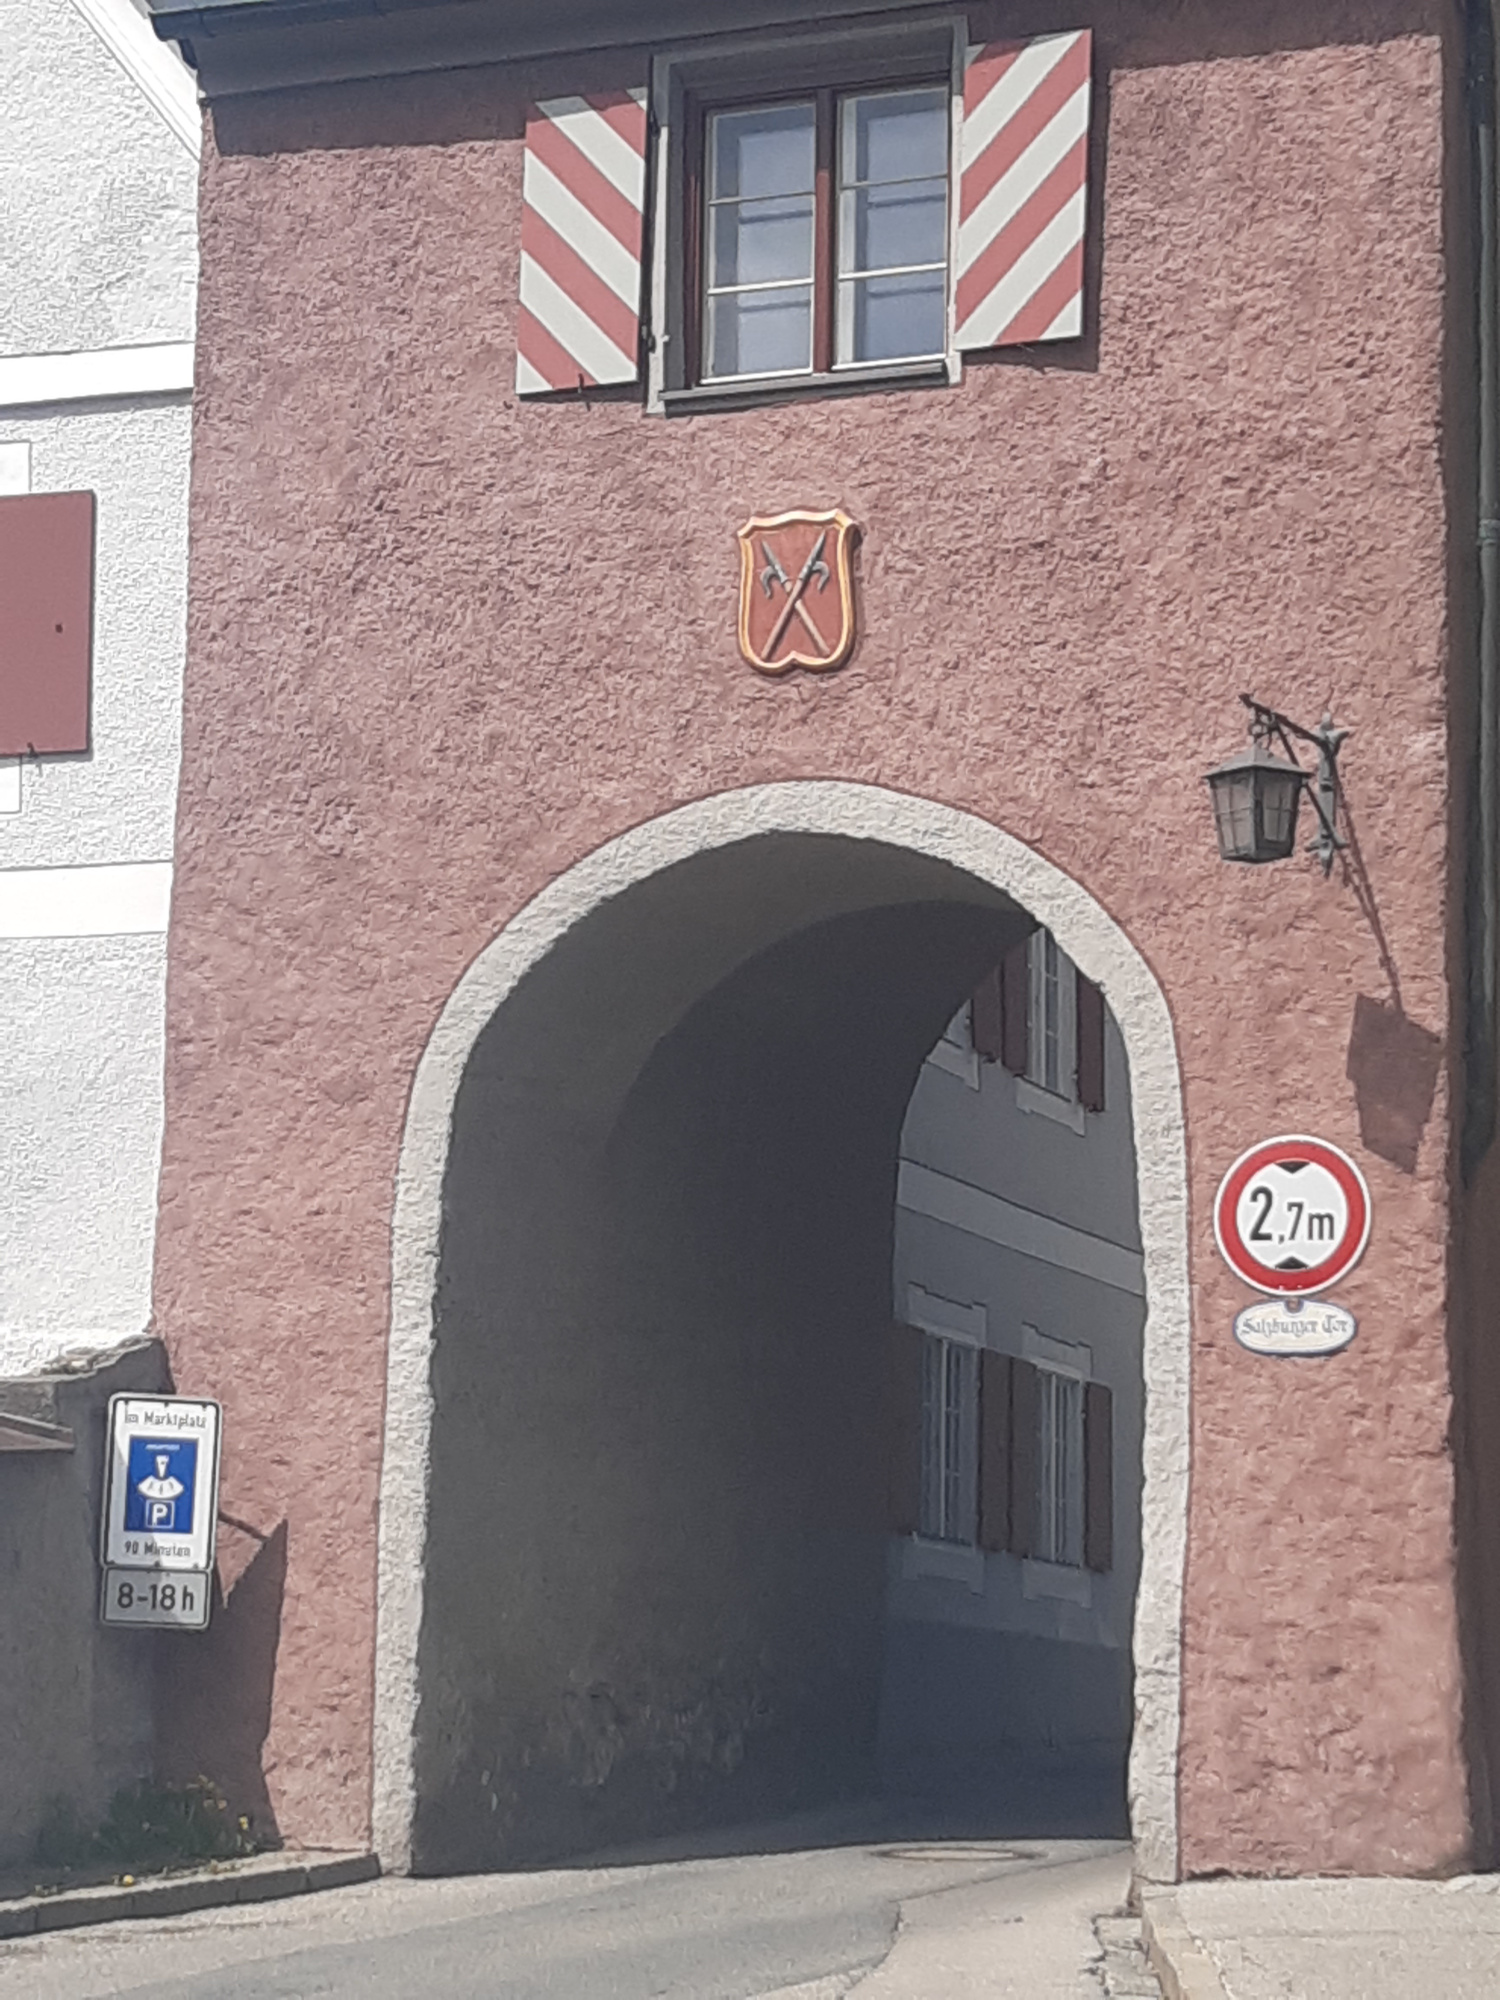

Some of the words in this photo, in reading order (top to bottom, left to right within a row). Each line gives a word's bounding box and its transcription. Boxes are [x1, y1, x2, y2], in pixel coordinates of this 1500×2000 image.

[1241, 1317, 1318, 1338] Salzburger
[1321, 1314, 1349, 1334] Tor
[144, 1410, 207, 1430] Marktplatz
[152, 1502, 168, 1526] P
[124, 1540, 140, 1556] 90
[144, 1541, 191, 1557] Minuten
[117, 1582, 176, 1611] 8-18
[182, 1584, 195, 1612] h
